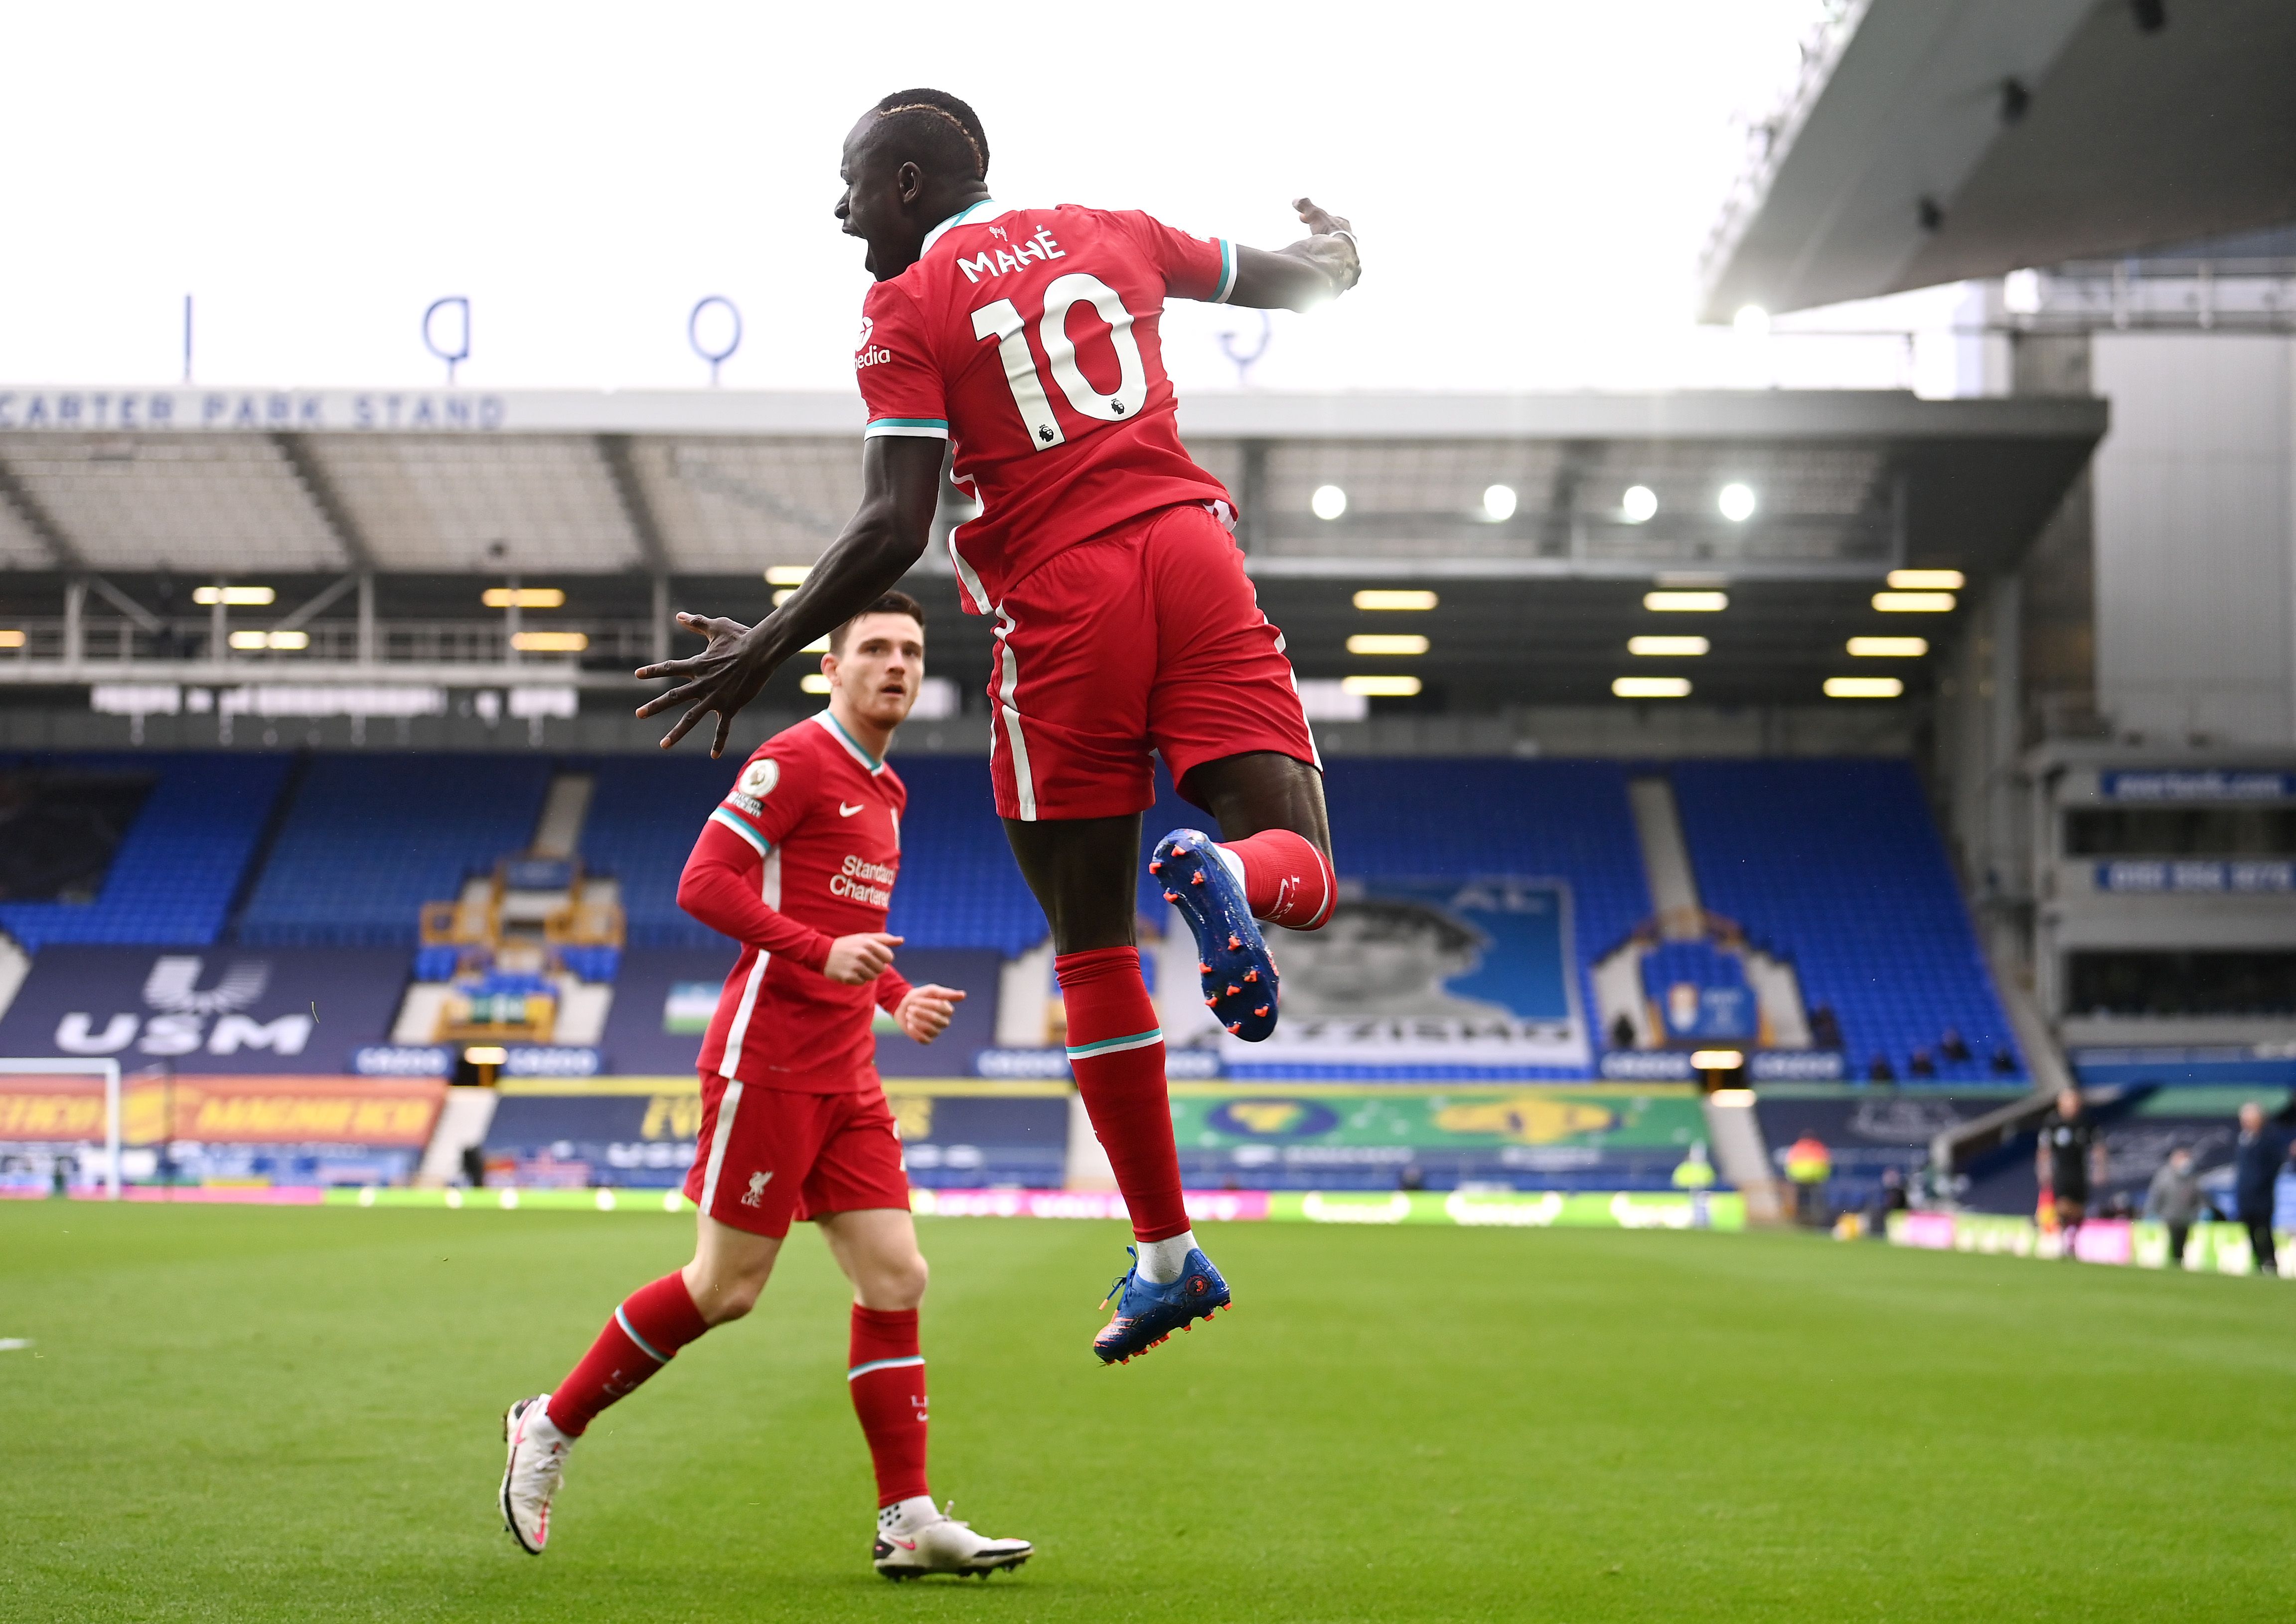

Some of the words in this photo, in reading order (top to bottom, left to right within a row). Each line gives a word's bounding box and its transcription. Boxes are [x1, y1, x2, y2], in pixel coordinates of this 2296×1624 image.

[957, 224, 1066, 283] MANÉ
[971, 273, 1148, 452] 10
[203, 392, 325, 428] PARK
[352, 392, 505, 428] STAND
[55, 1012, 312, 1055] USM
